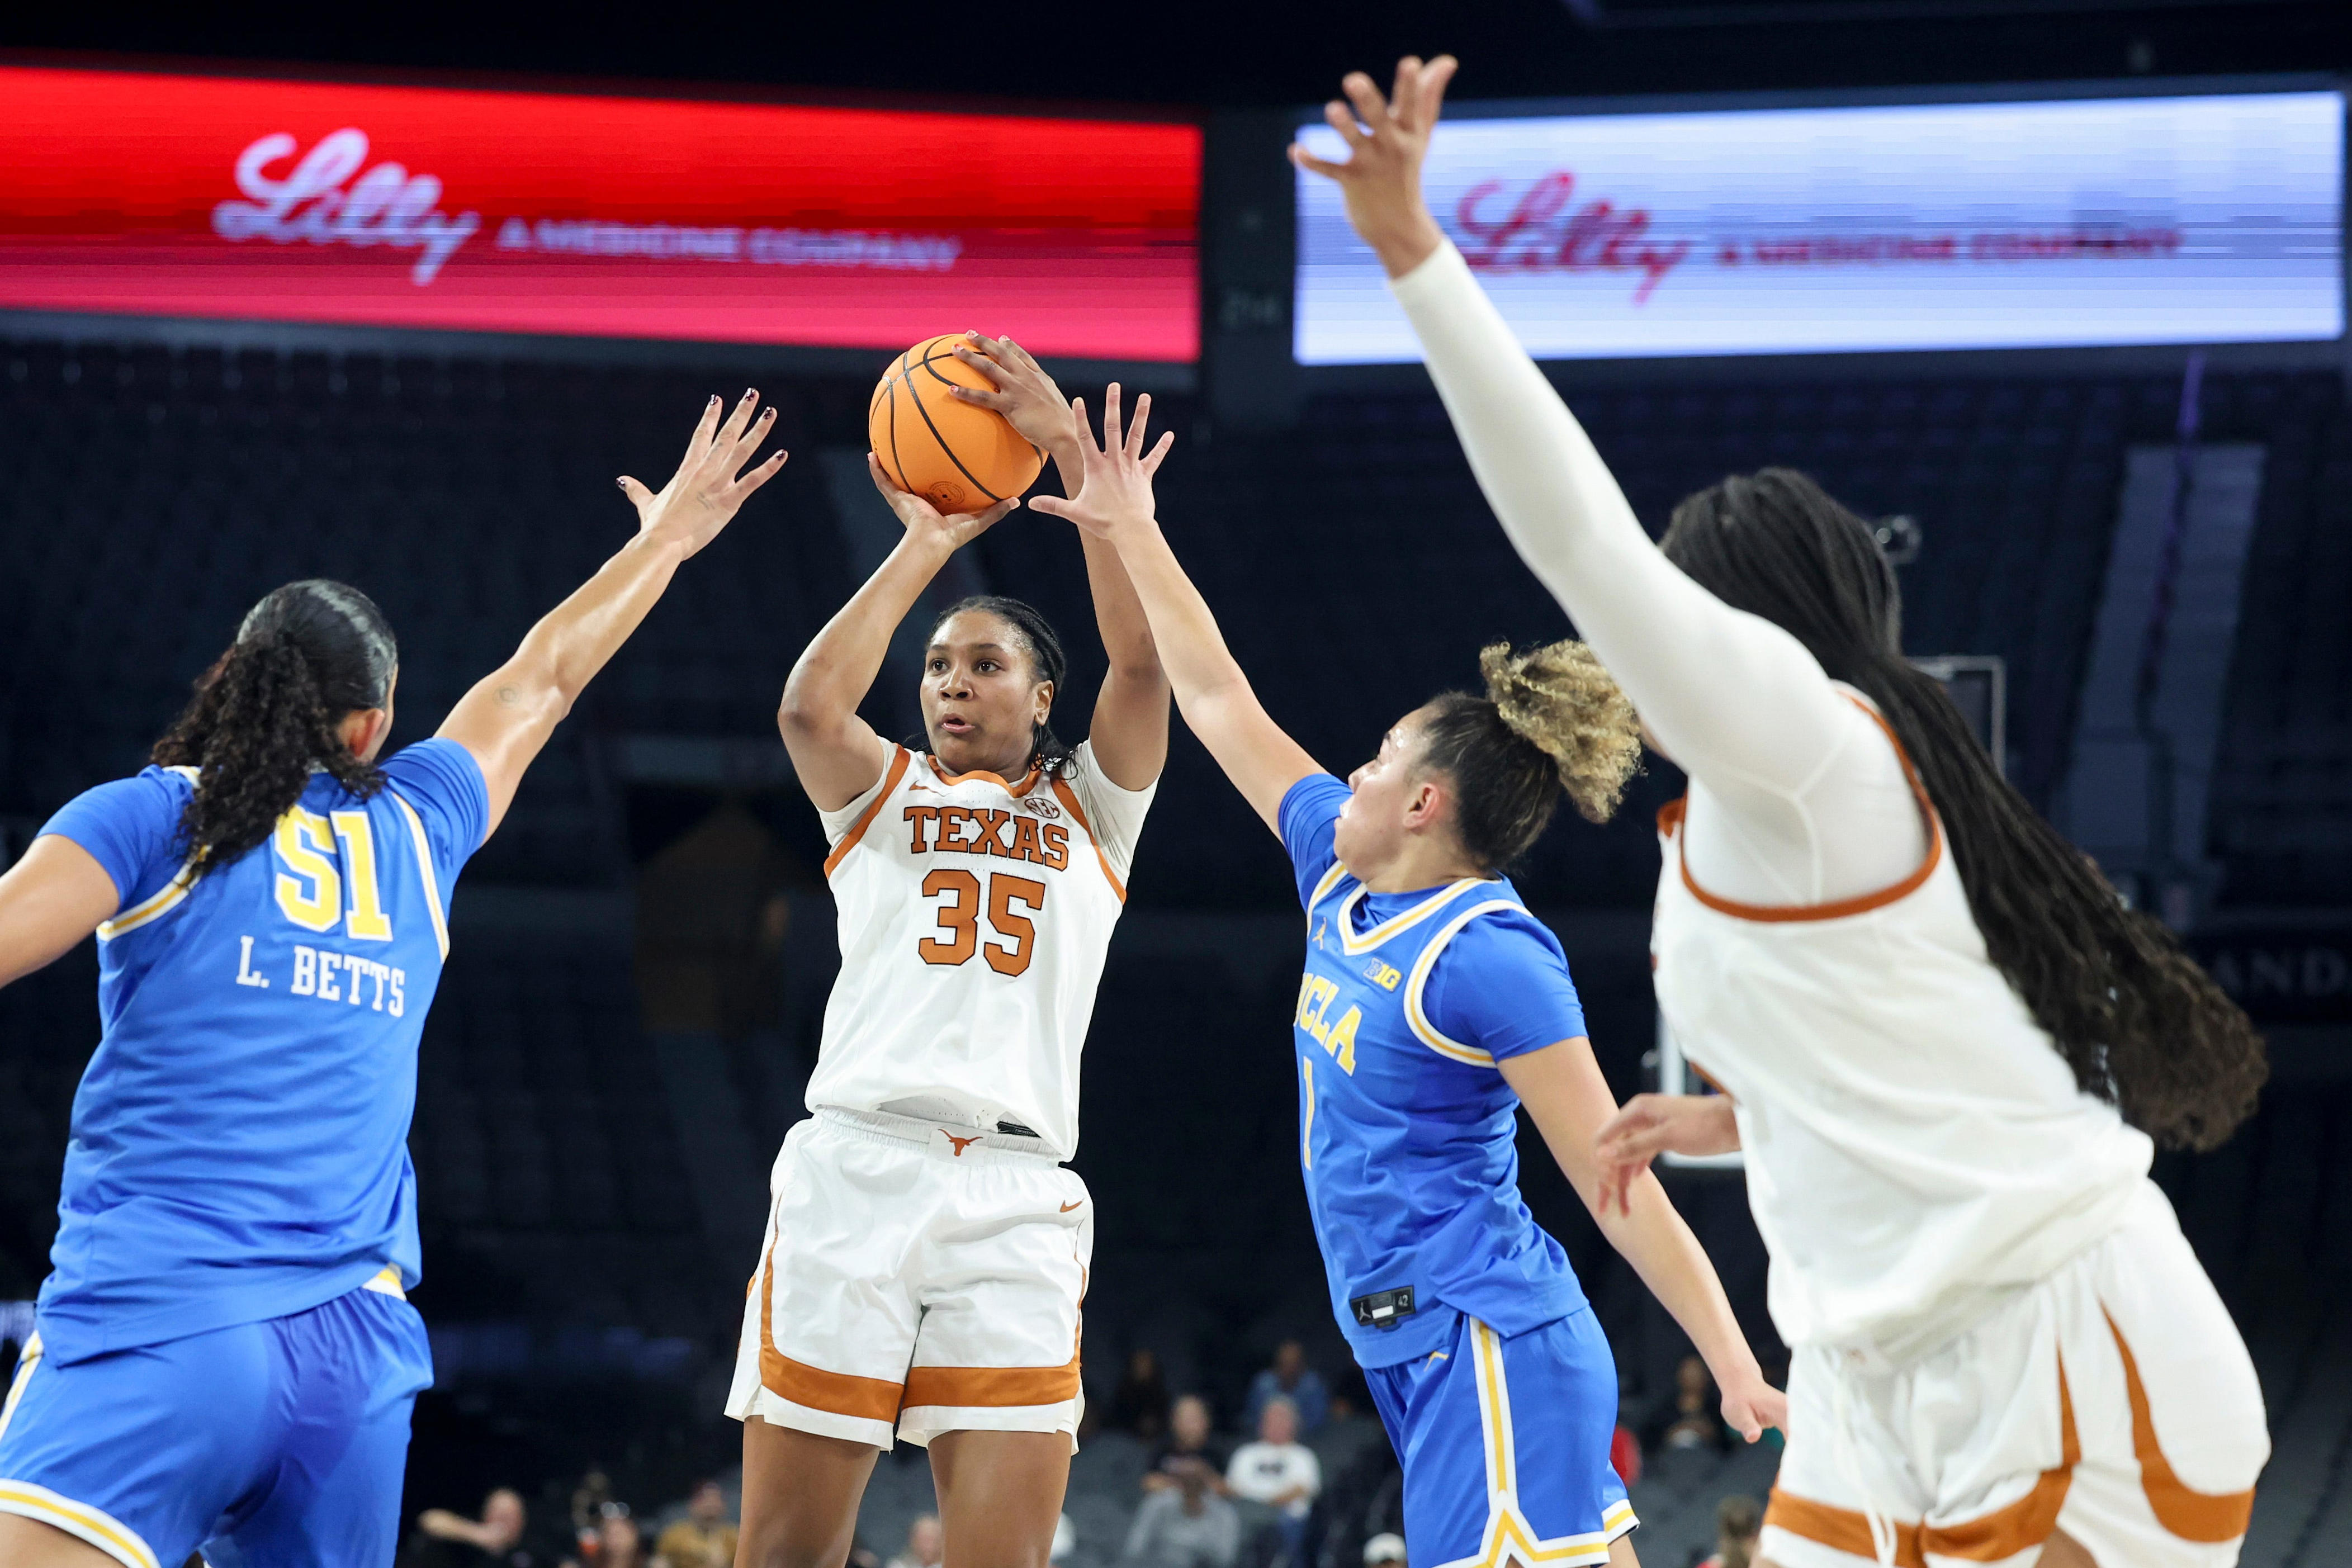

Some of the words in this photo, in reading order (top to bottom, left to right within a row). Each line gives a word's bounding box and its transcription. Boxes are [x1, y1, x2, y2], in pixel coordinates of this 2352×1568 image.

[212, 129, 479, 285] Lilly
[498, 216, 528, 252] A
[748, 228, 960, 271] COMPANY
[1456, 169, 1690, 303] Lilly
[903, 806, 1069, 871] TEXAS
[1025, 799, 1059, 818] SEC
[274, 804, 393, 941] 51
[919, 869, 1045, 977] 35
[235, 935, 269, 988] L.
[290, 945, 405, 1017] BETTS
[1363, 957, 1402, 992] BIG
[1303, 1056, 1315, 1172] 1
[1398, 1294, 1408, 1306] 42
